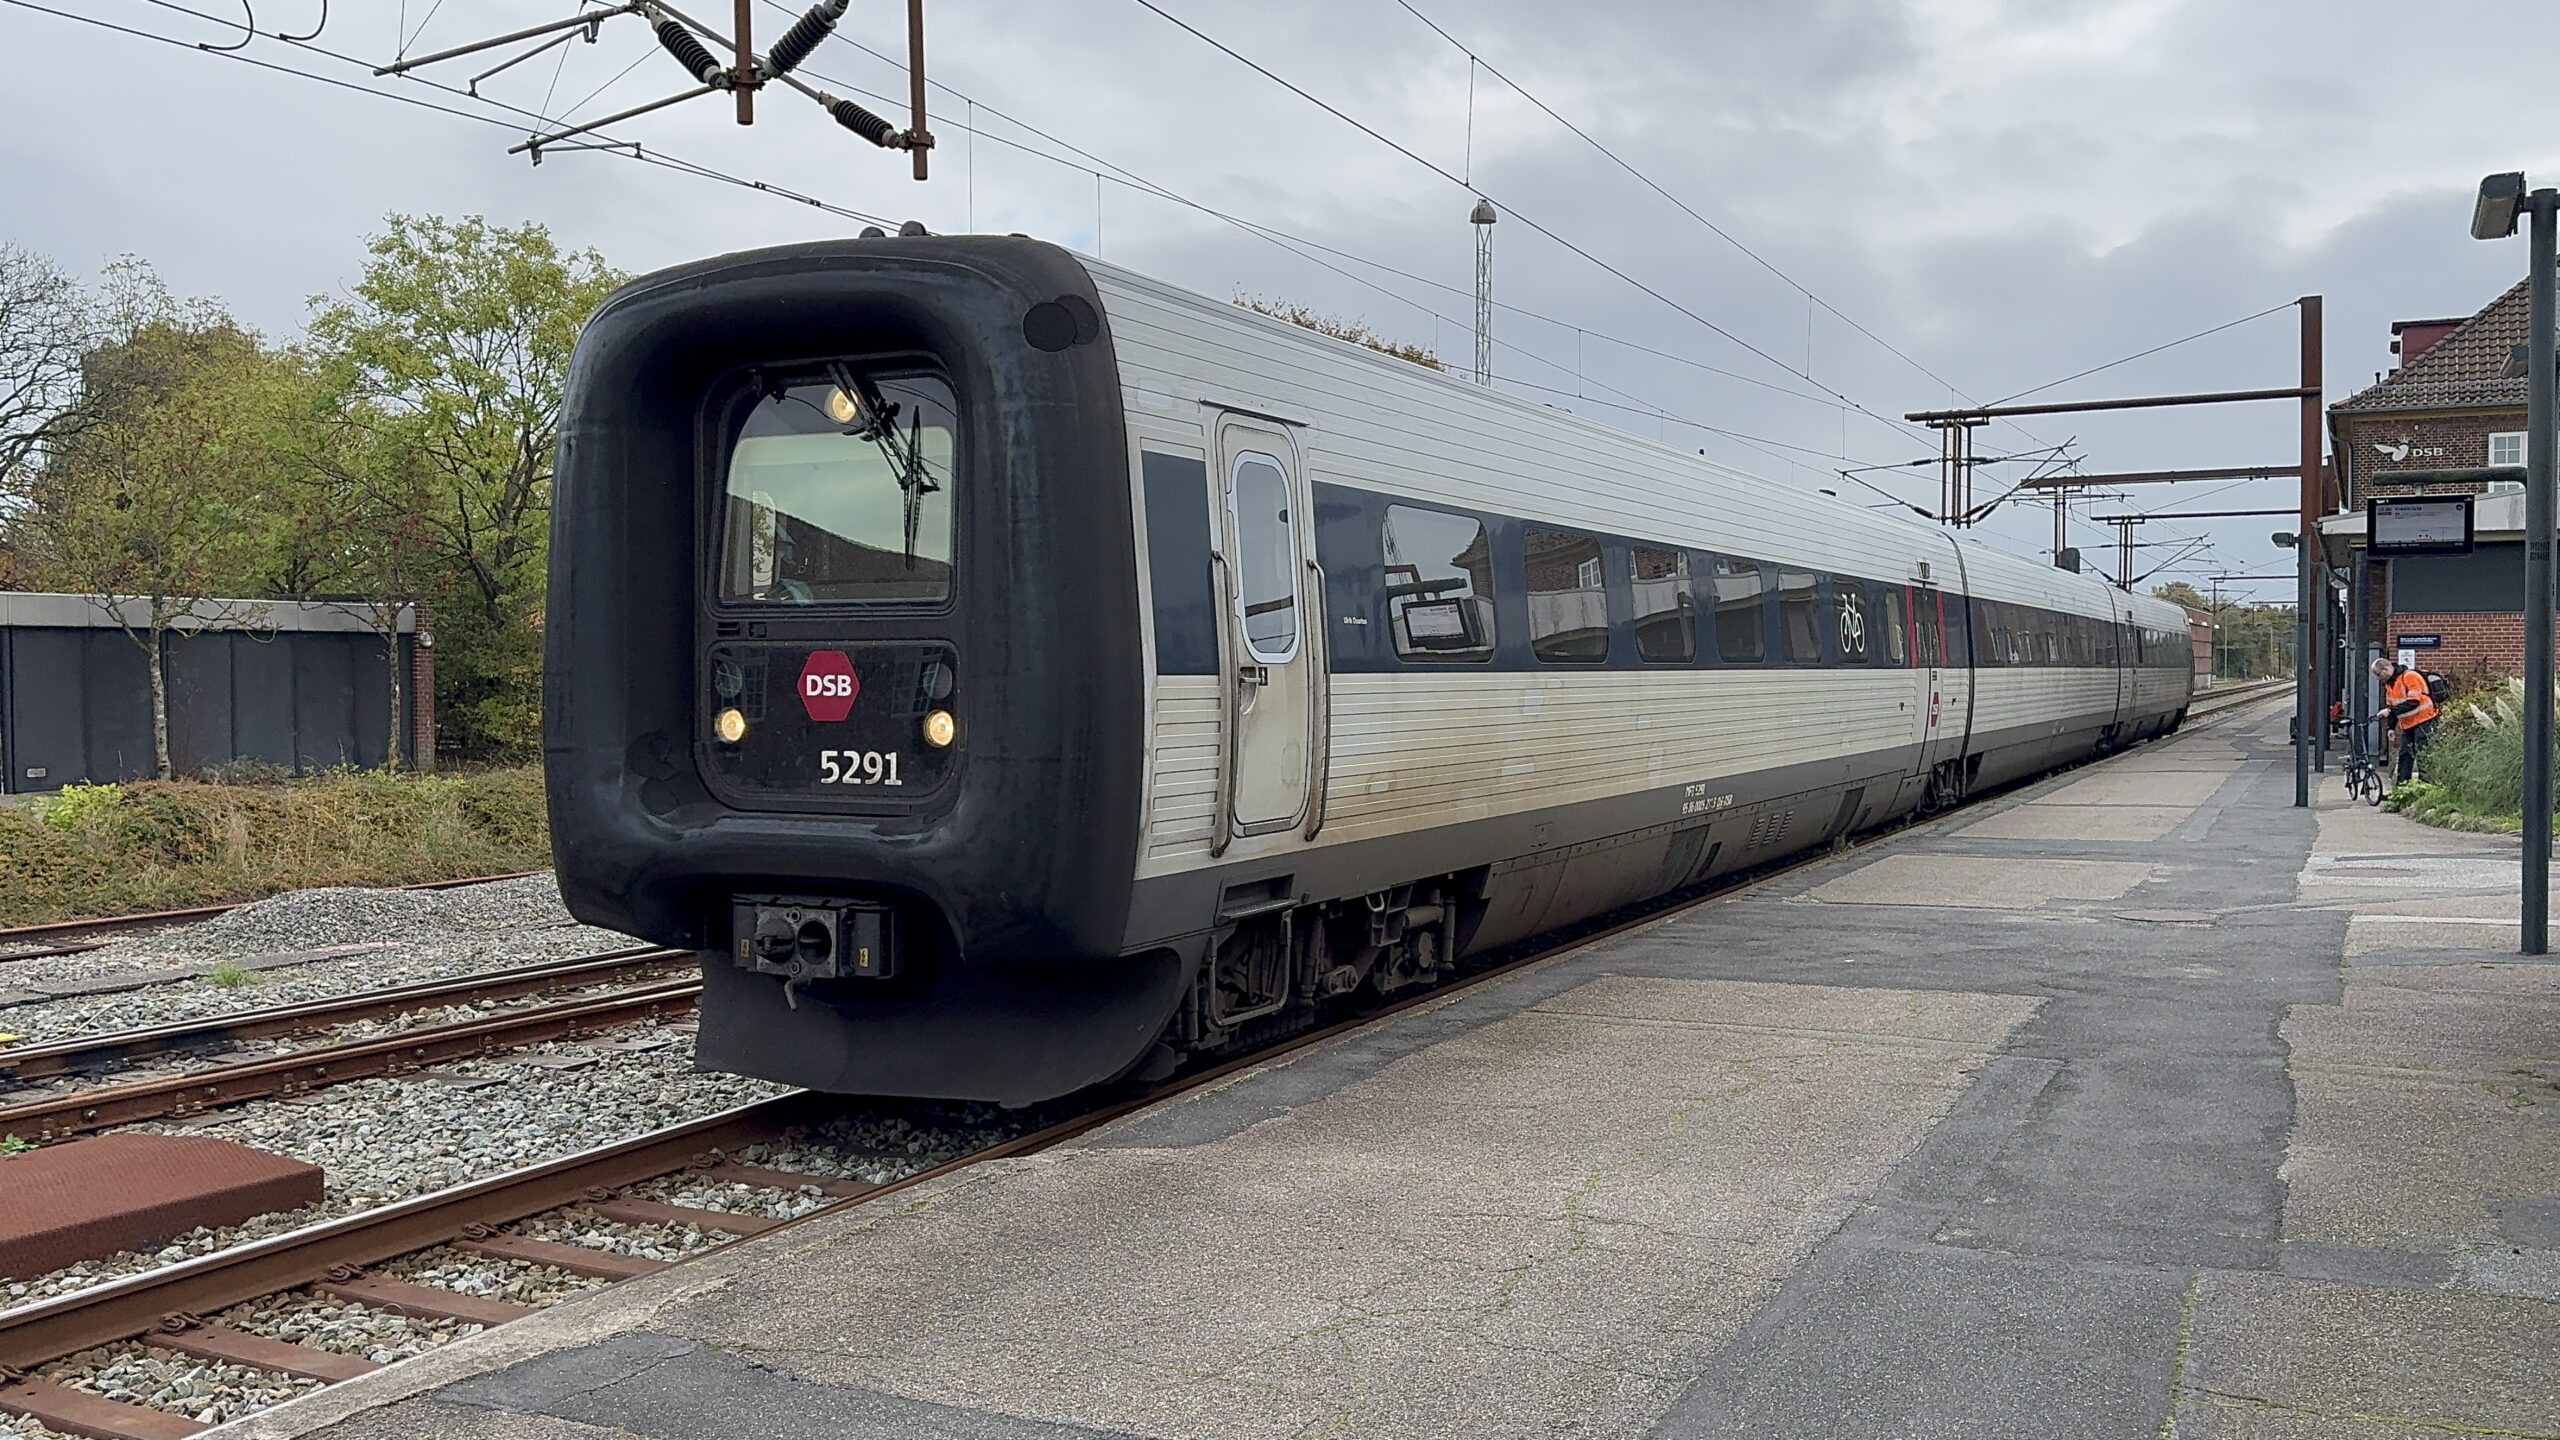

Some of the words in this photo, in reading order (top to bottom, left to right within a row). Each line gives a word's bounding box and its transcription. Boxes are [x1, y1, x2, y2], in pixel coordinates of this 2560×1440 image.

[2413, 447, 2443, 457] DSB
[806, 674, 852, 696] DSB
[820, 750, 902, 785] 5291
